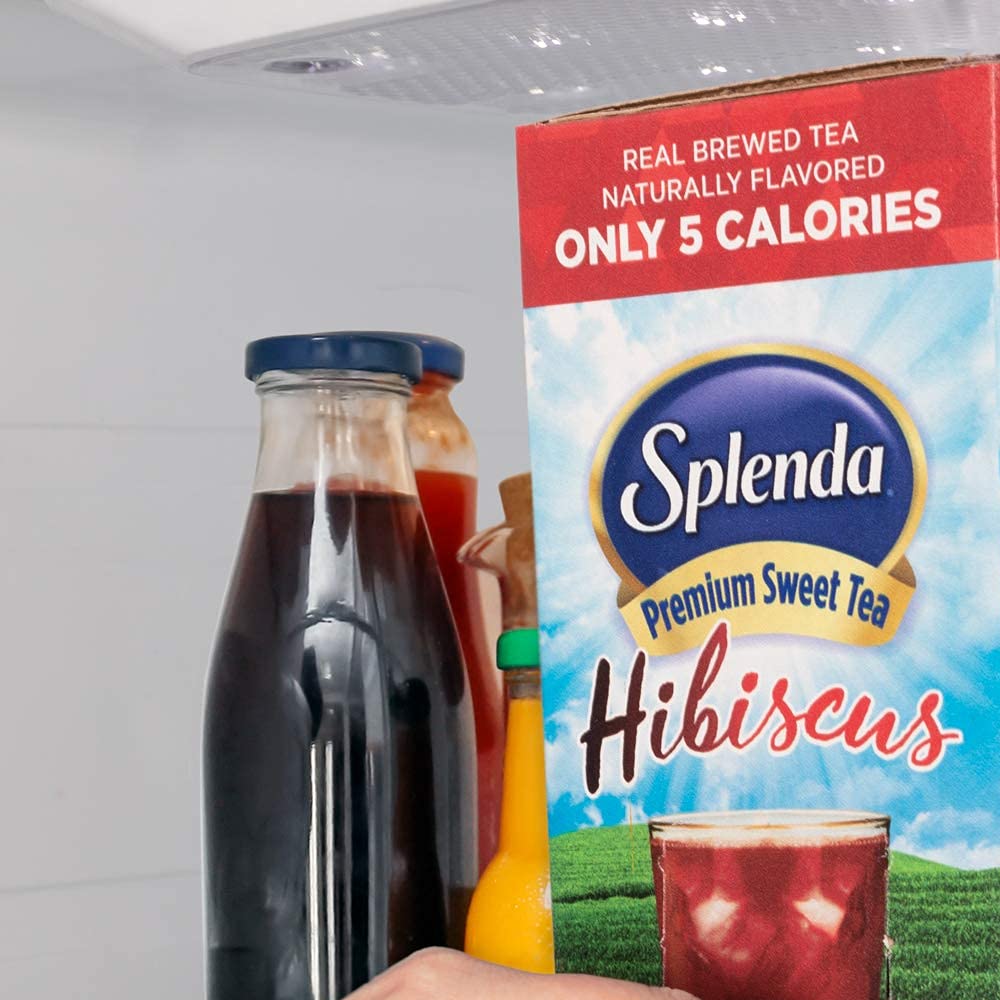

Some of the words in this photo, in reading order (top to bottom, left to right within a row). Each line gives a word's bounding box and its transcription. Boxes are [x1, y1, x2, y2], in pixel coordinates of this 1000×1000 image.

[602, 171, 743, 210] NATURALLY
[751, 154, 886, 191] FLAVORED
[622, 143, 685, 171] REAL
[693, 127, 801, 162] BREWED
[809, 120, 859, 148] TEA
[555, 218, 665, 269] ONLY
[679, 215, 703, 256] 5
[715, 188, 942, 251] CALORIES
[620, 422, 885, 534] Splenda
[640, 571, 757, 640] Premium
[761, 562, 841, 611] Sweet
[846, 573, 891, 630] Tea
[579, 621, 961, 795] Hibiscus
